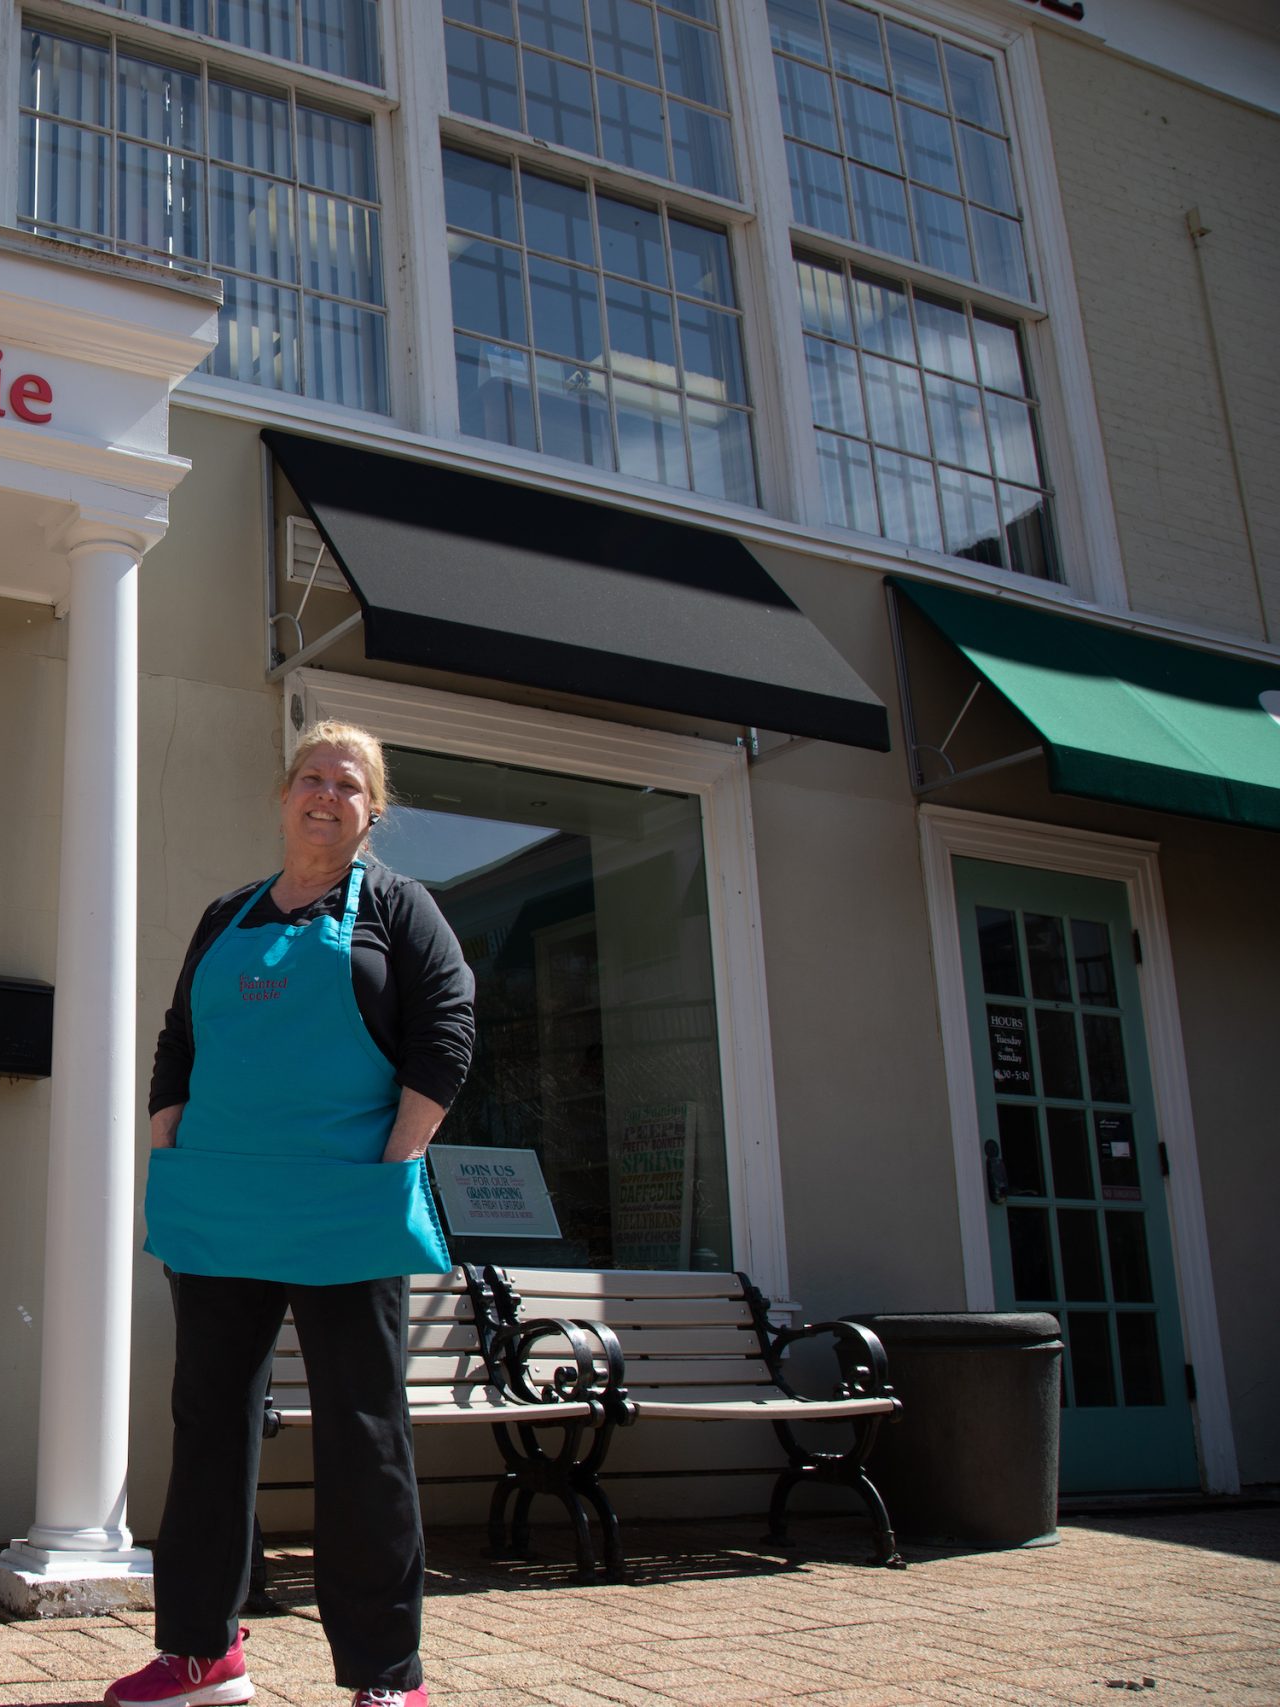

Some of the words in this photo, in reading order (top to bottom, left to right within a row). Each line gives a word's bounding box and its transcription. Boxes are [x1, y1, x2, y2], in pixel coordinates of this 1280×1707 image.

[991, 1015, 1023, 1028] HOURS
[994, 1033, 1021, 1046] Tuesday
[997, 1051, 1022, 1064] Sunday
[623, 1140, 649, 1154] PRETTY
[651, 1136, 685, 1150] BONNETS
[621, 1148, 684, 1174] SPRING
[460, 1163, 491, 1176] JOIN
[493, 1165, 515, 1176] US
[472, 1177, 490, 1186] FOR
[491, 1177, 510, 1186] OUR
[466, 1186, 491, 1199] GRAND
[492, 1187, 523, 1200] OPENING
[644, 1229, 681, 1244] CHICKS
